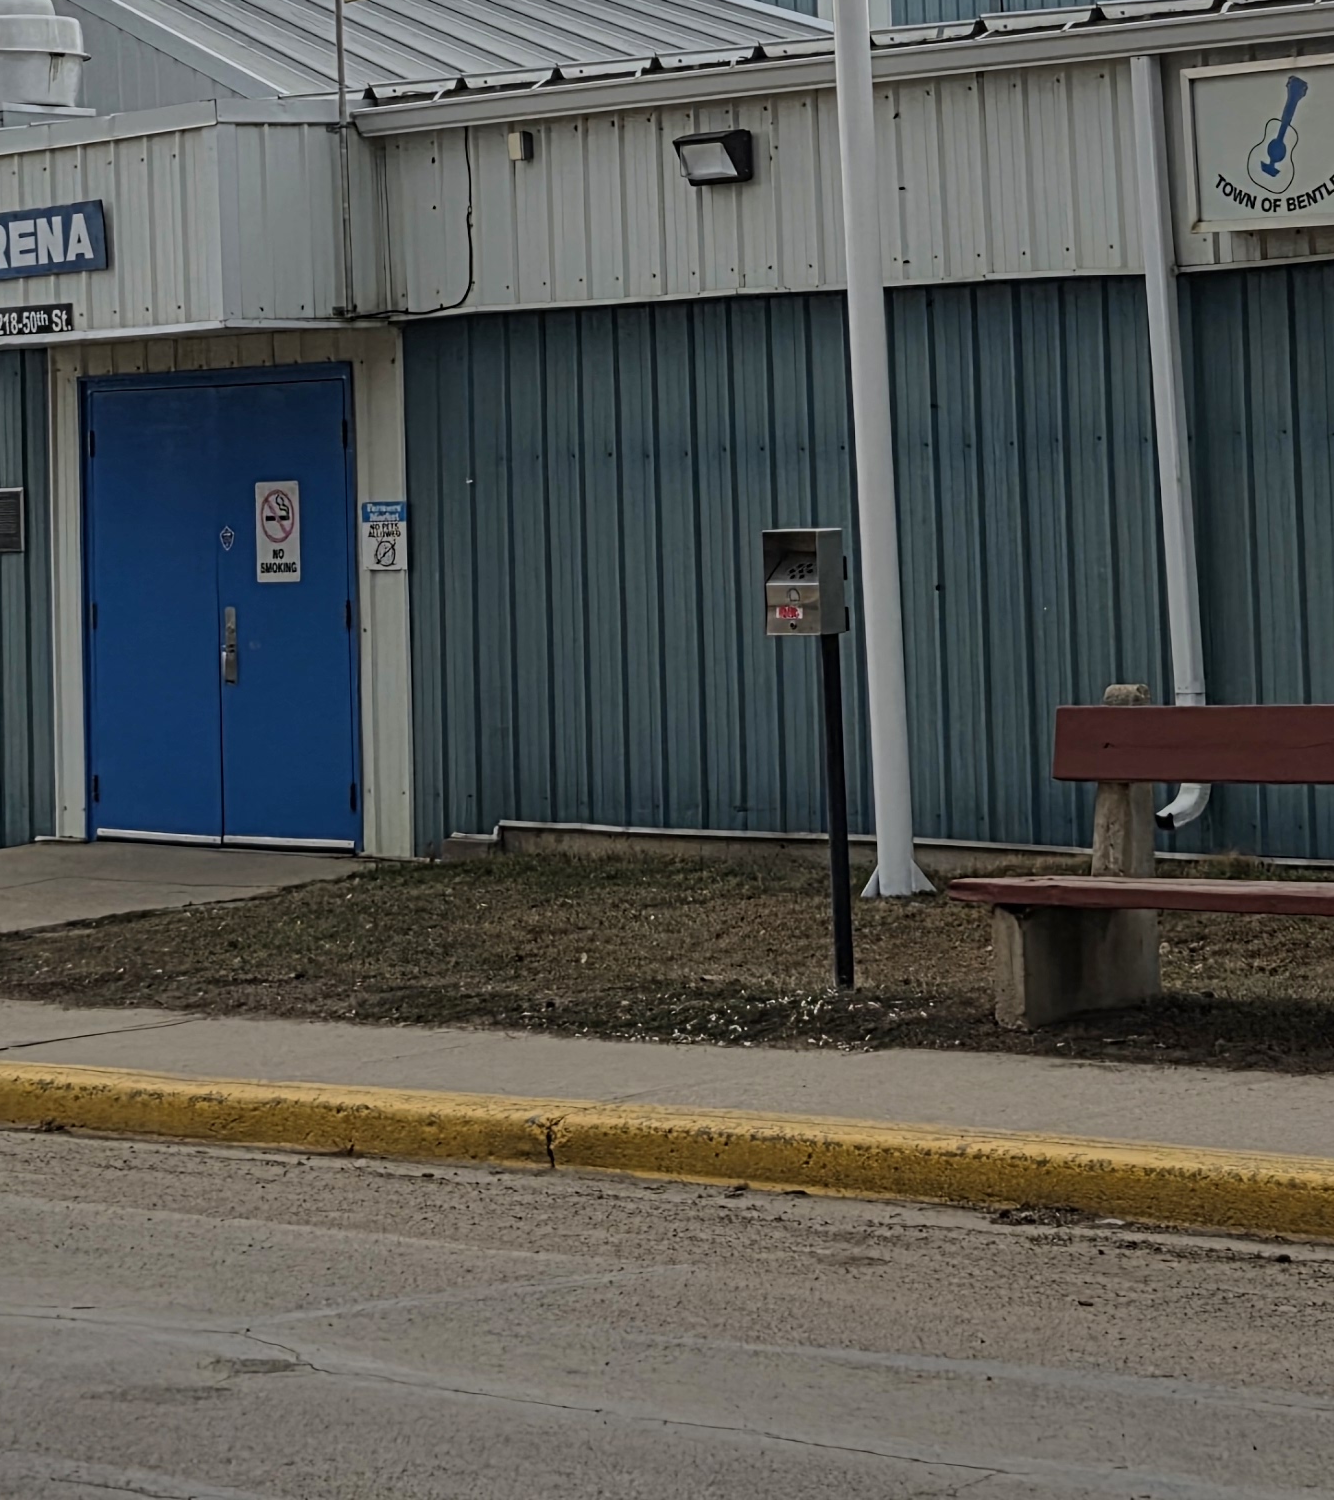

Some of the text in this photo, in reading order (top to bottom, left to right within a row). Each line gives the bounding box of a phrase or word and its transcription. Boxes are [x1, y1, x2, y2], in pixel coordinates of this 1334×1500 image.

[1215, 174, 1257, 210] TOWN
[1261, 198, 1282, 213] OF
[51, 309, 72, 332] St.
[368, 530, 401, 538] ALLOWED
[272, 548, 284, 560] NO
[261, 562, 297, 574] SMOKING
